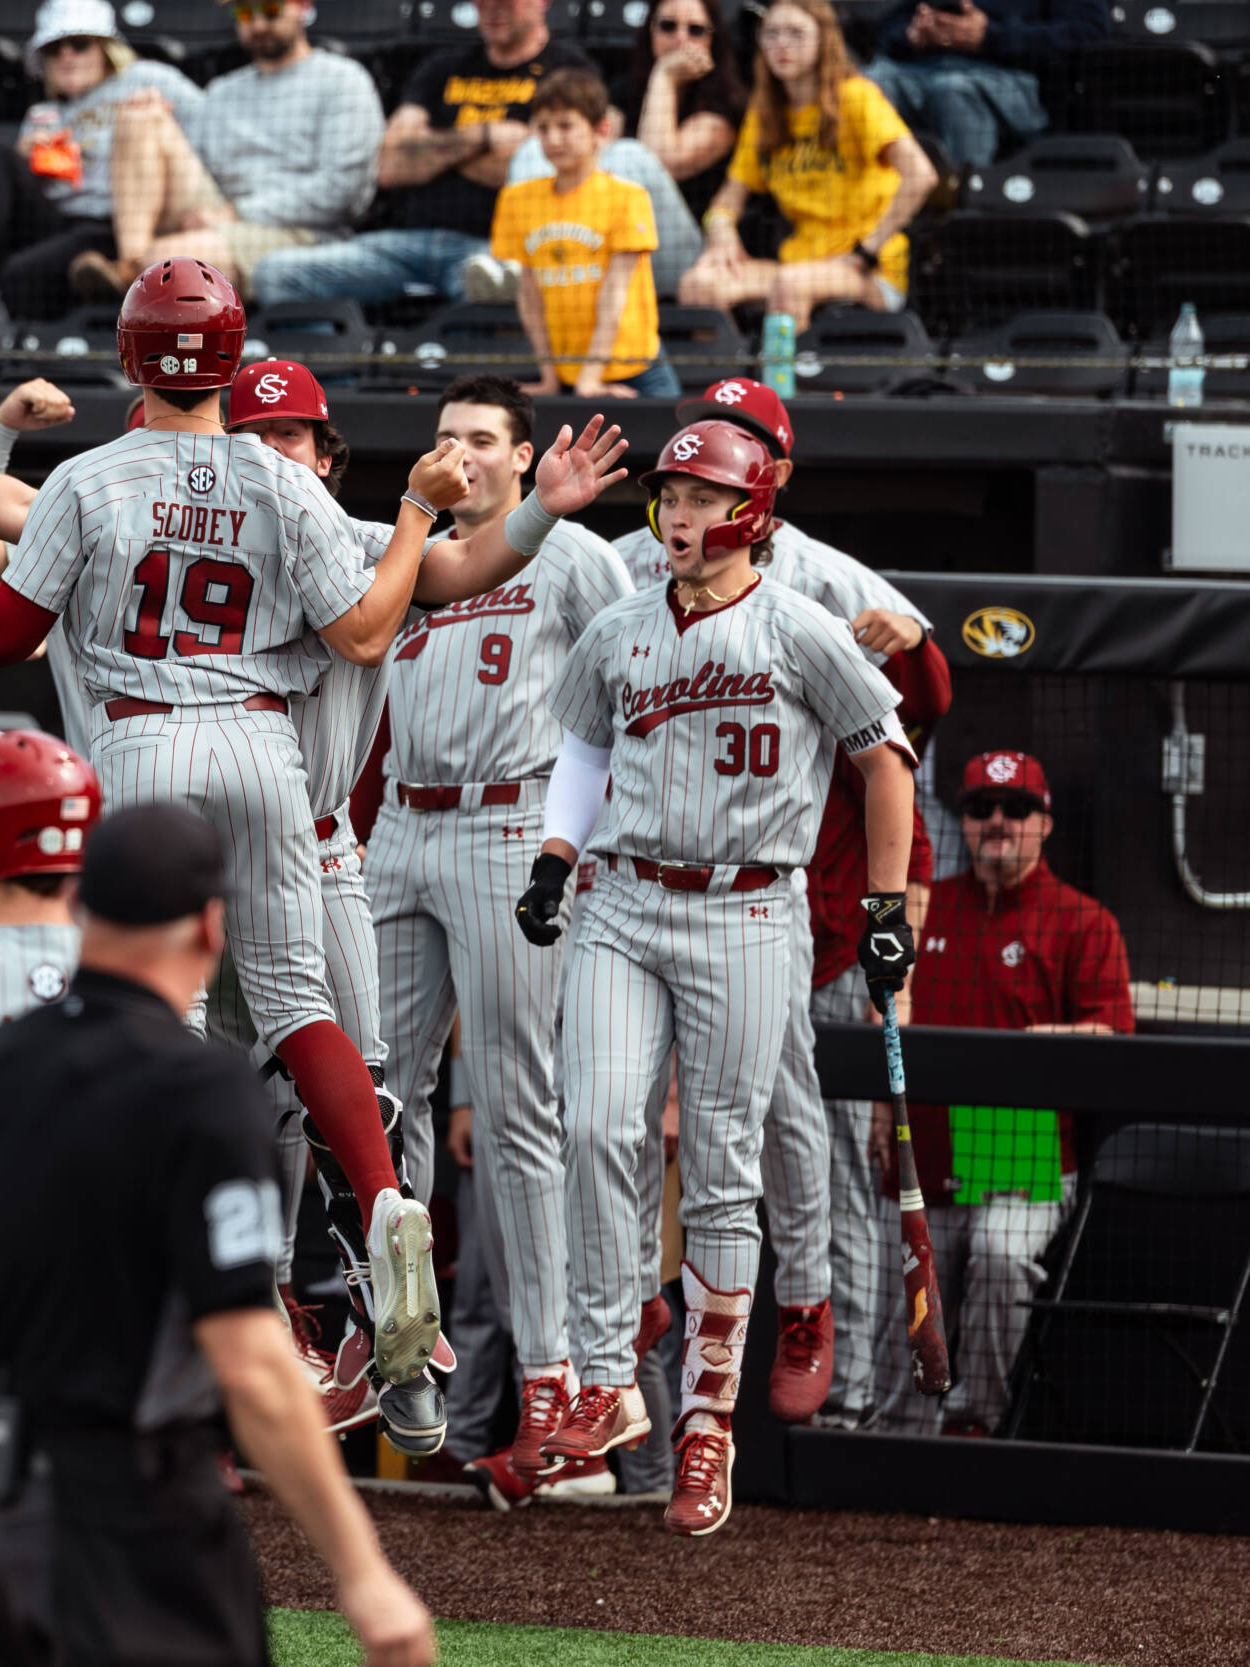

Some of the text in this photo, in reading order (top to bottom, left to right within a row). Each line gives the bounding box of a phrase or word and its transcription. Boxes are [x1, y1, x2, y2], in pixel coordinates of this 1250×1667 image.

[183, 358, 197, 373] 19
[190, 467, 214, 493] SEC
[152, 502, 247, 546] SCOBEY
[124, 549, 255, 660] 19
[478, 633, 512, 685] 9
[622, 660, 773, 721] Carolina
[714, 721, 780, 777] 30
[842, 719, 887, 753] MAN
